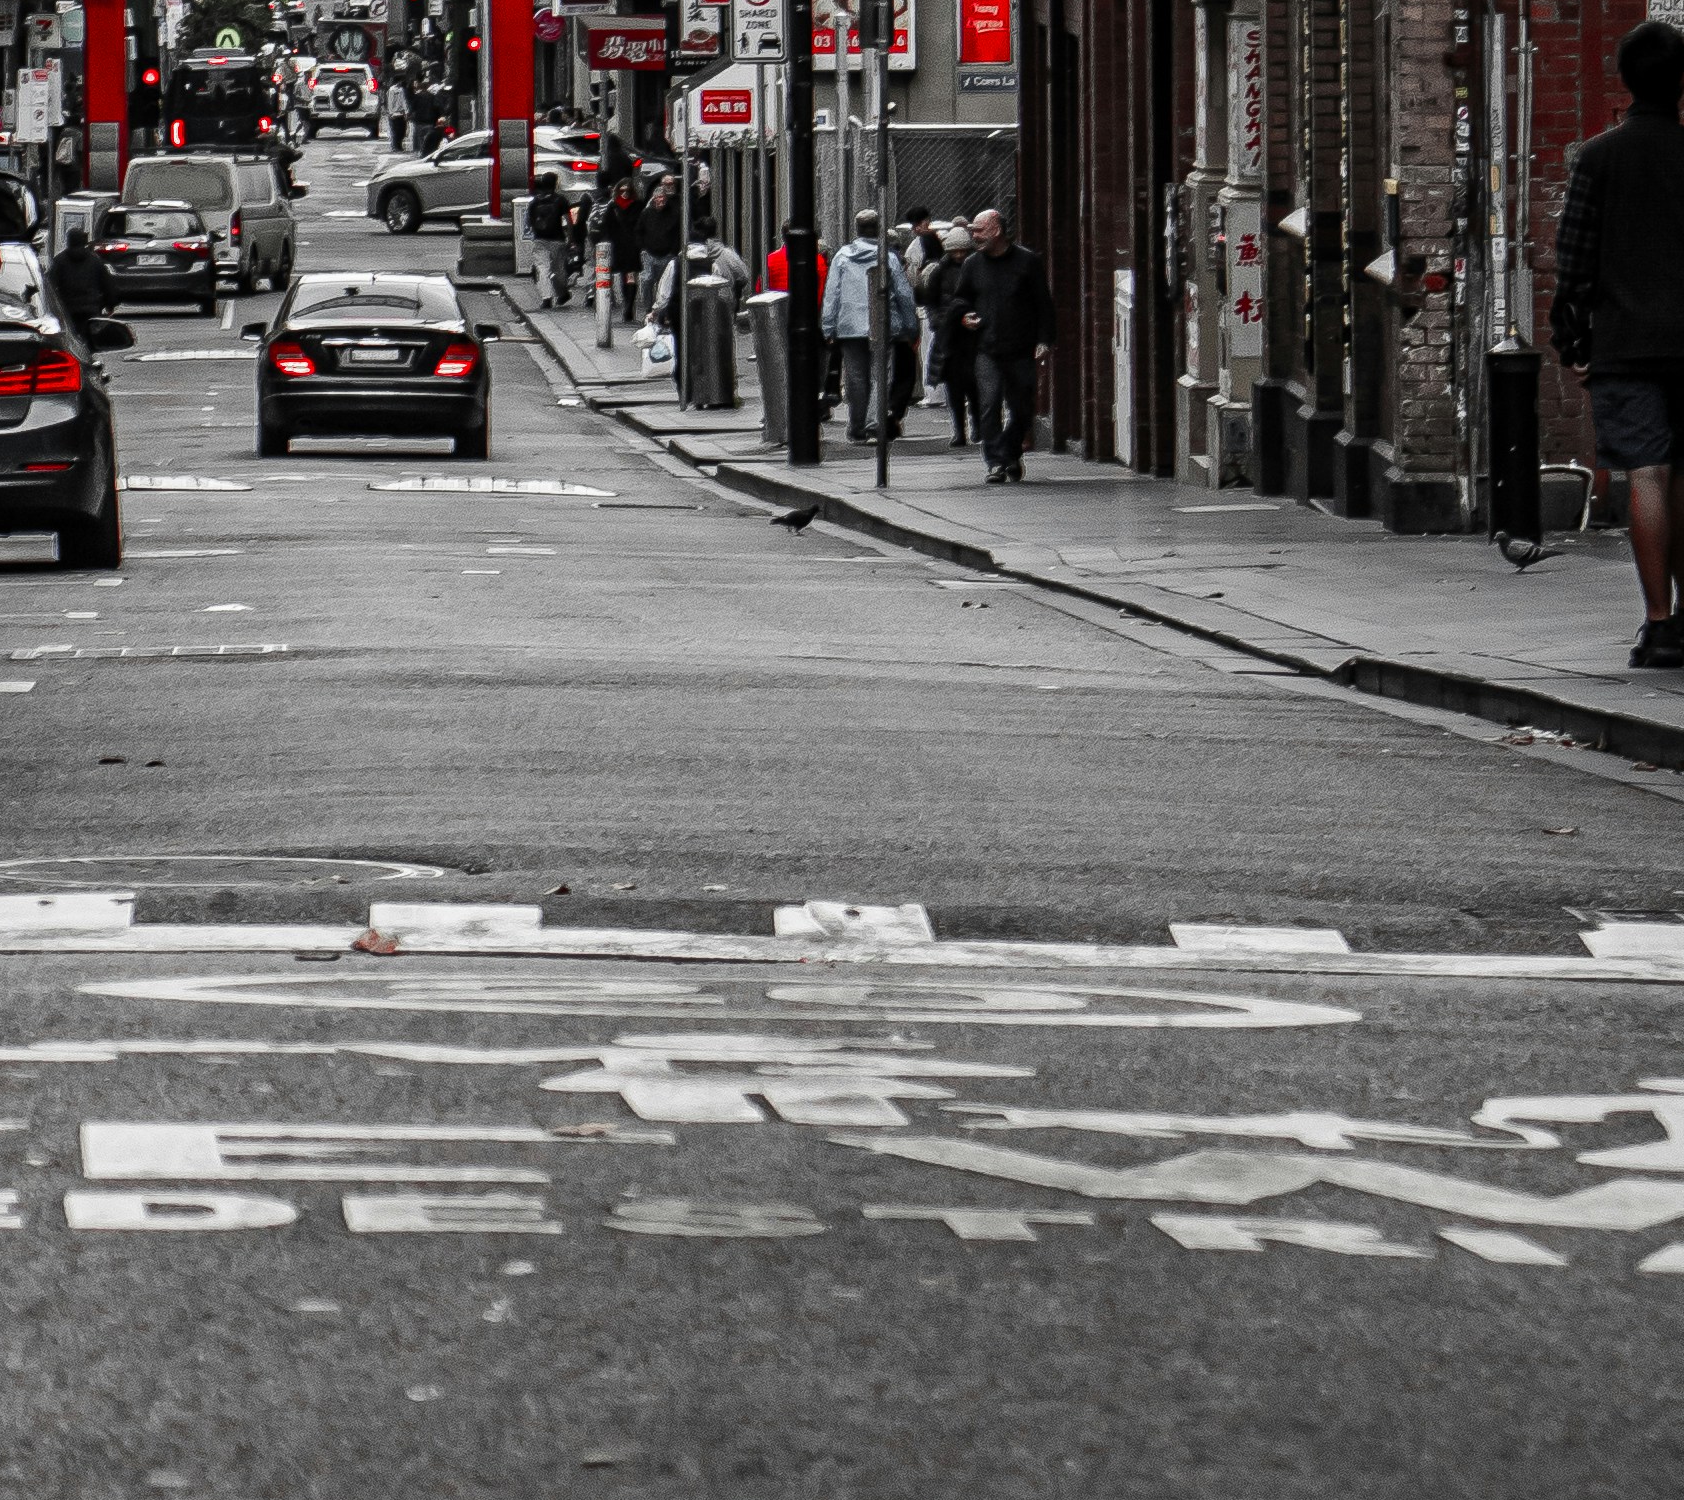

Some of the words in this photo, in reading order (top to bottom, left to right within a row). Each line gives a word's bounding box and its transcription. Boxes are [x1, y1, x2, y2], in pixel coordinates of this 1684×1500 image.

[738, 8, 778, 19] SHARED
[745, 20, 772, 30] ZONE
[388, 977, 1090, 1011] 20
